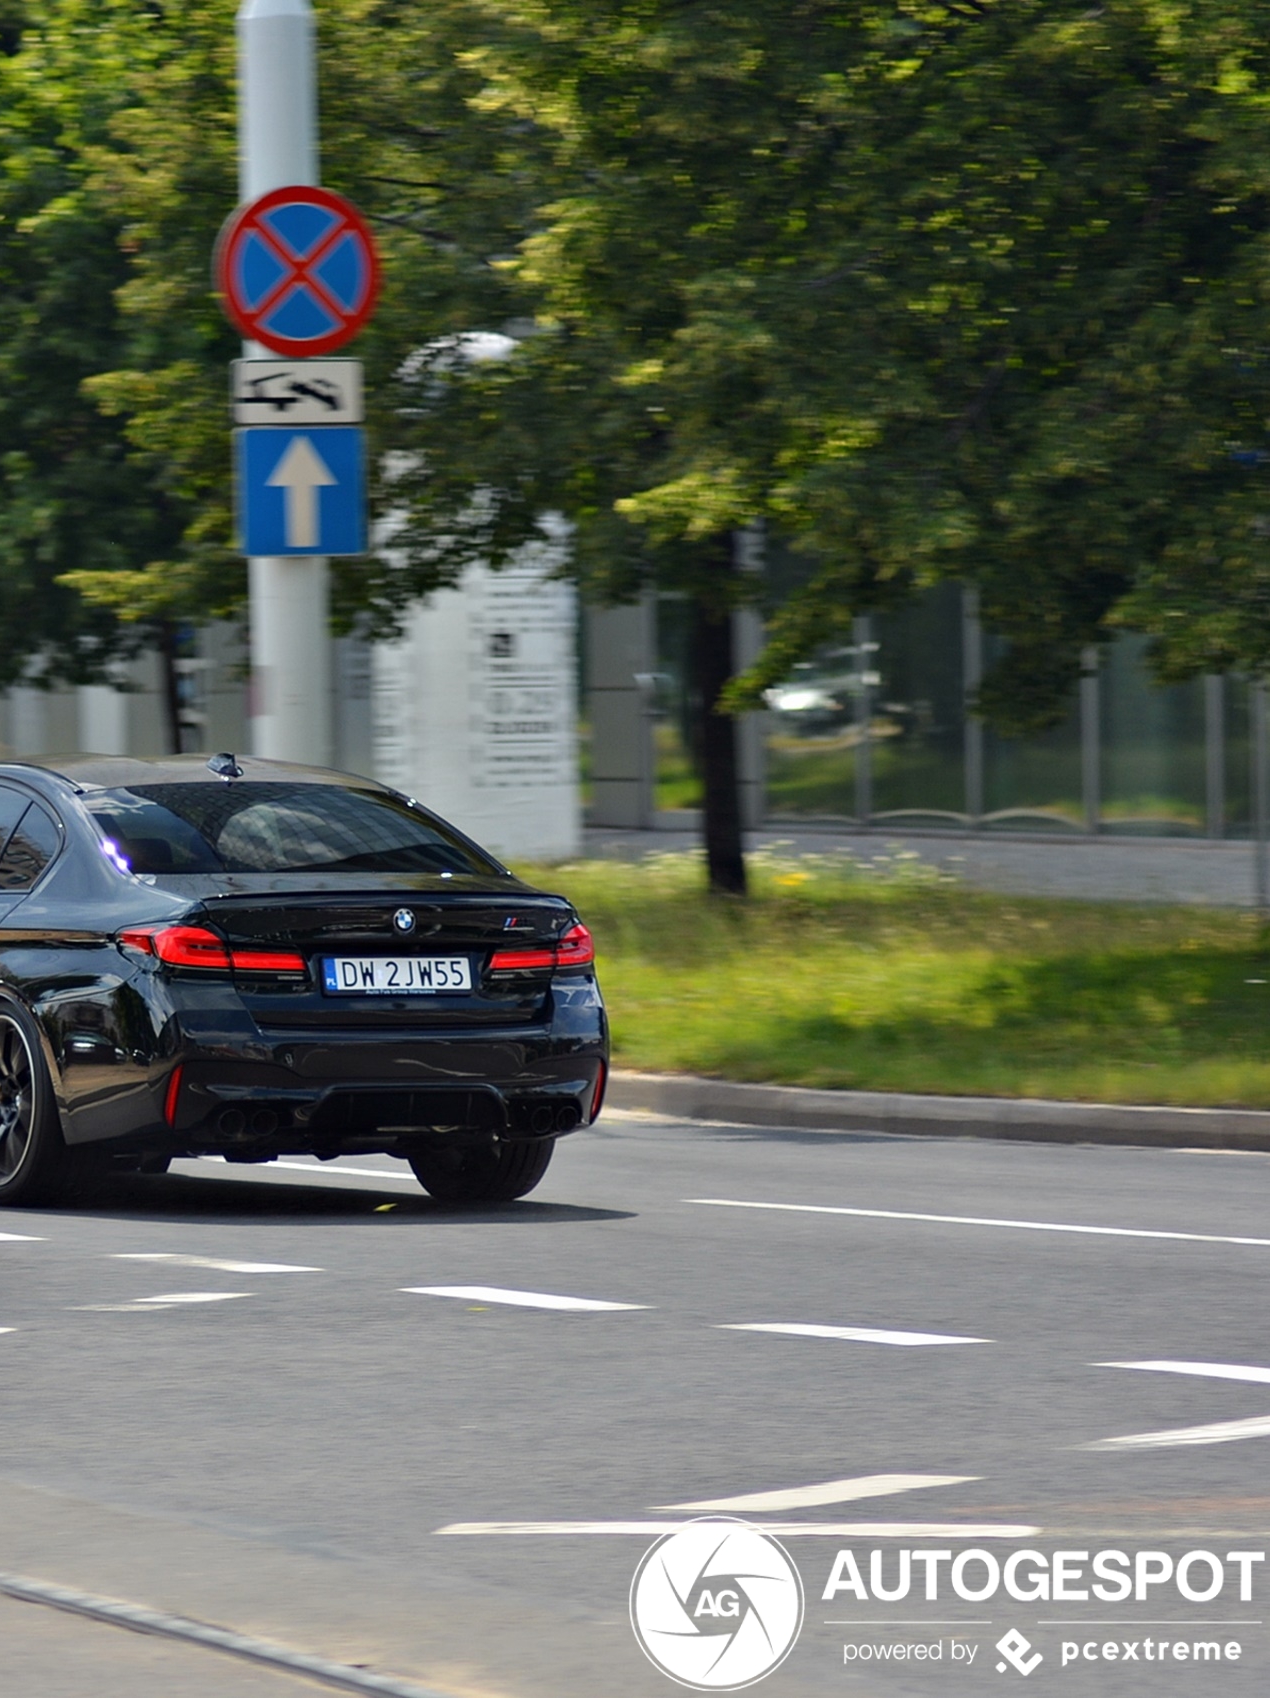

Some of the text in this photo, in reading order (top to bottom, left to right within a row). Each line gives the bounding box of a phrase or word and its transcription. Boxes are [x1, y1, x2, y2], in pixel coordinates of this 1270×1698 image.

[326, 977, 337, 986] PL
[342, 961, 464, 987] DW 2JW55
